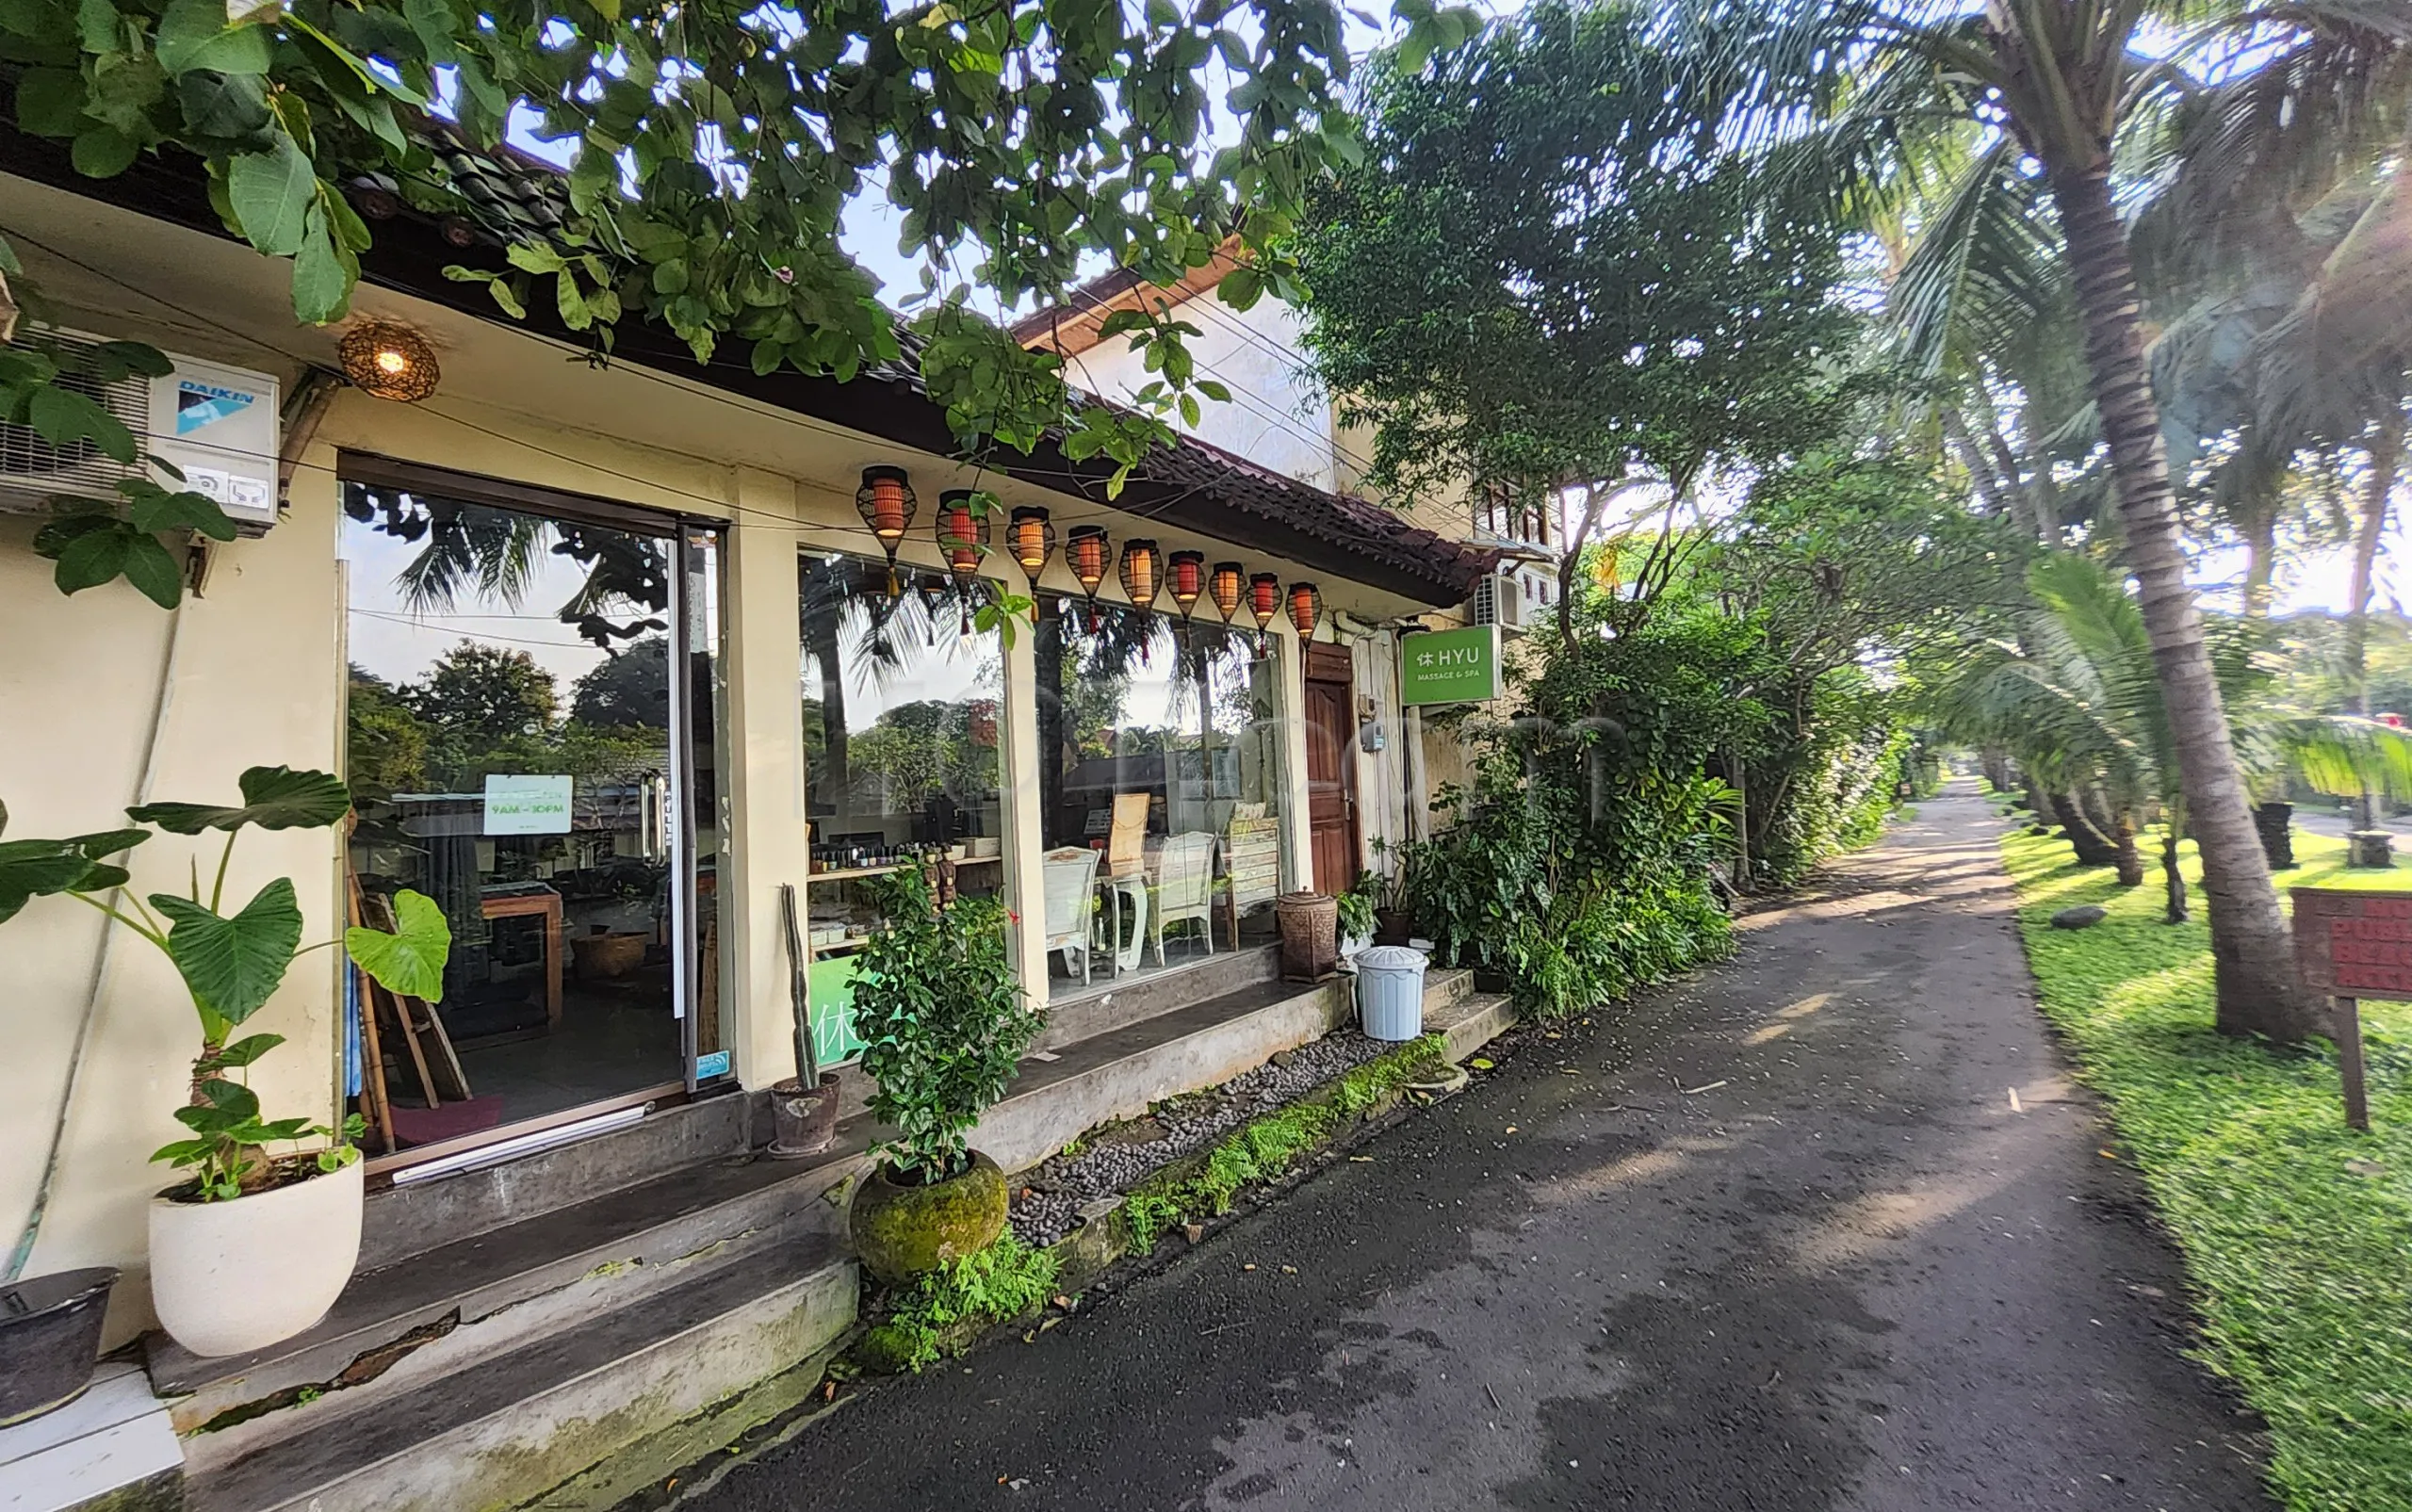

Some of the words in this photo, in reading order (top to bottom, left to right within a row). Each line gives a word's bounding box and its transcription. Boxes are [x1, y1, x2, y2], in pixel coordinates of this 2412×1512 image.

[180, 381, 254, 403] DAIKIN
[1439, 647, 1479, 666] HYU
[1417, 672, 1454, 680] MASSAGE
[492, 805, 520, 814] 9AM
[813, 1000, 873, 1058] 休
